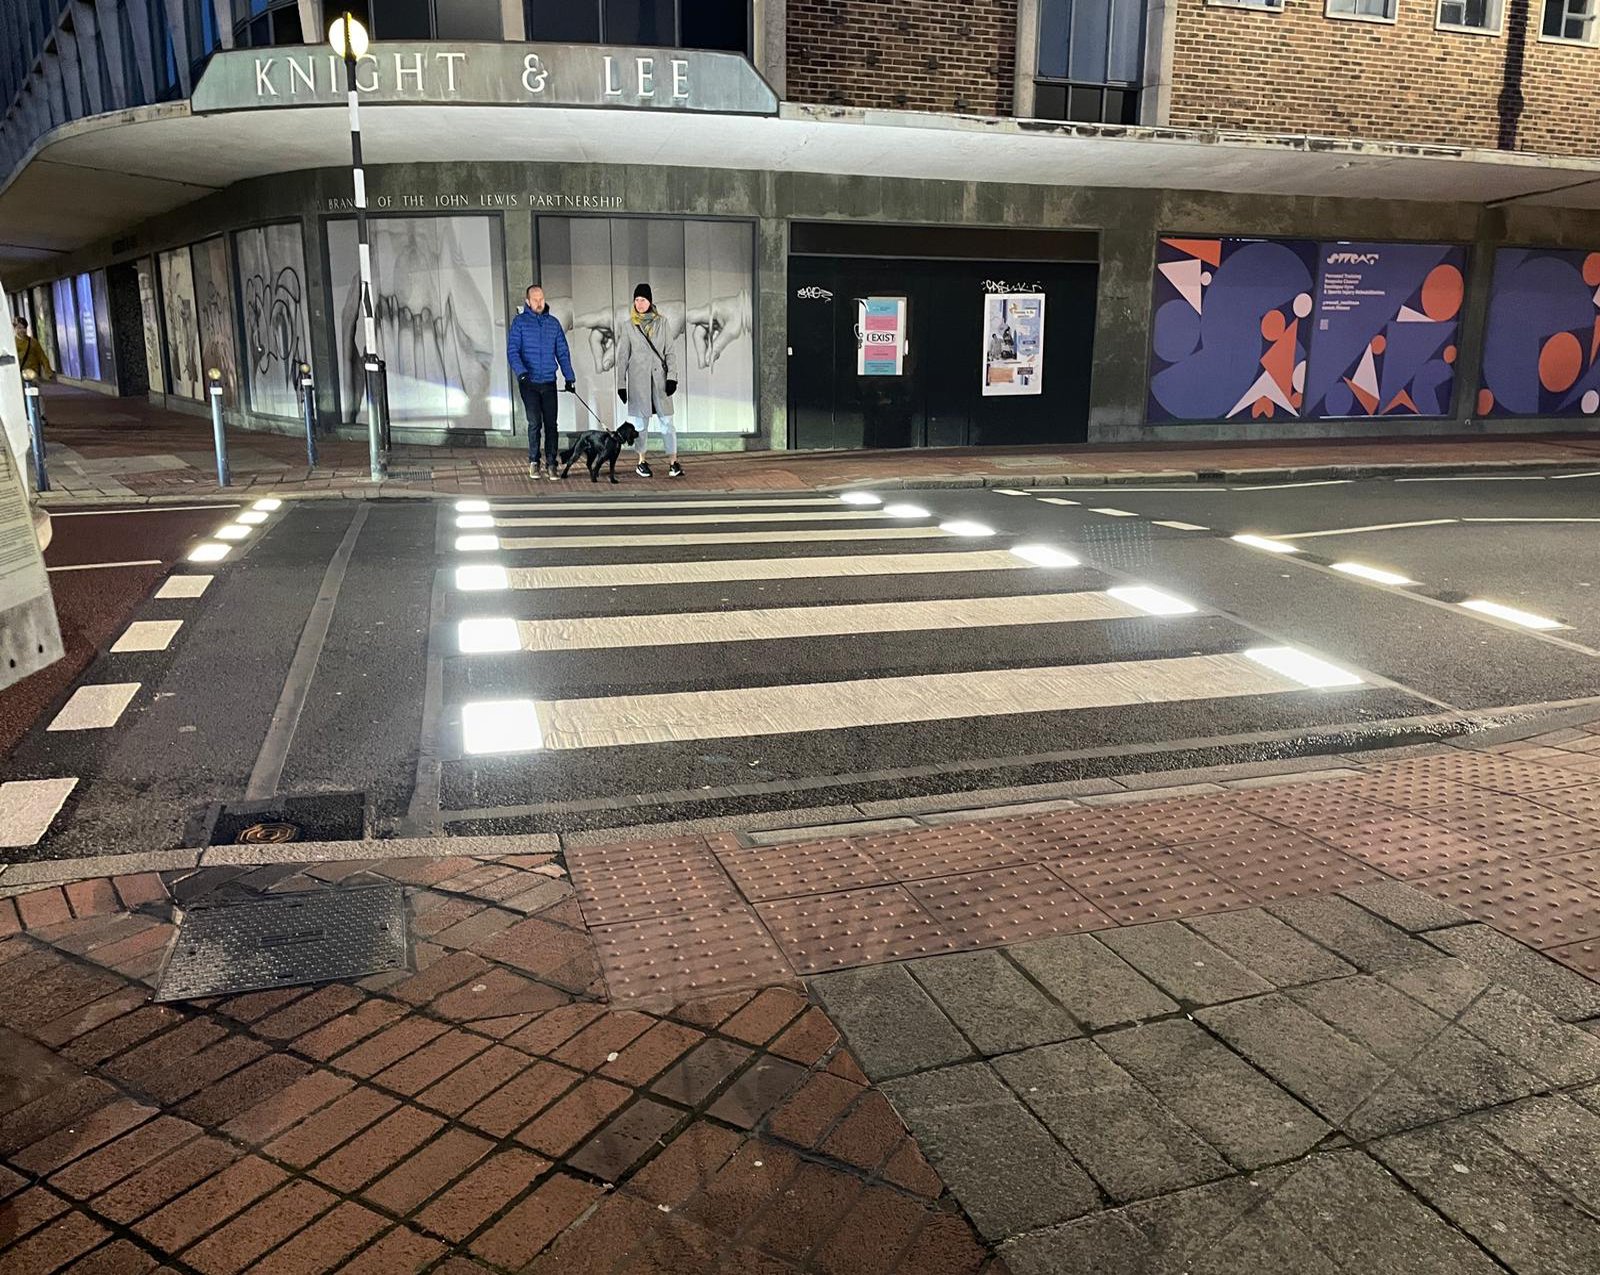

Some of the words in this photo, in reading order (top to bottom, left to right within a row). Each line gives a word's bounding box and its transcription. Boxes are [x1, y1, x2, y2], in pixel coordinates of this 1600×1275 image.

[255, 53, 466, 96] KNIGHT
[521, 53, 548, 93] &
[603, 56, 689, 98] LEE
[377, 195, 392, 208] OF
[403, 195, 425, 207] THE
[480, 194, 518, 206] LEWIS
[529, 195, 623, 208] PARTNERSHIP
[871, 333, 896, 342] EXIST
